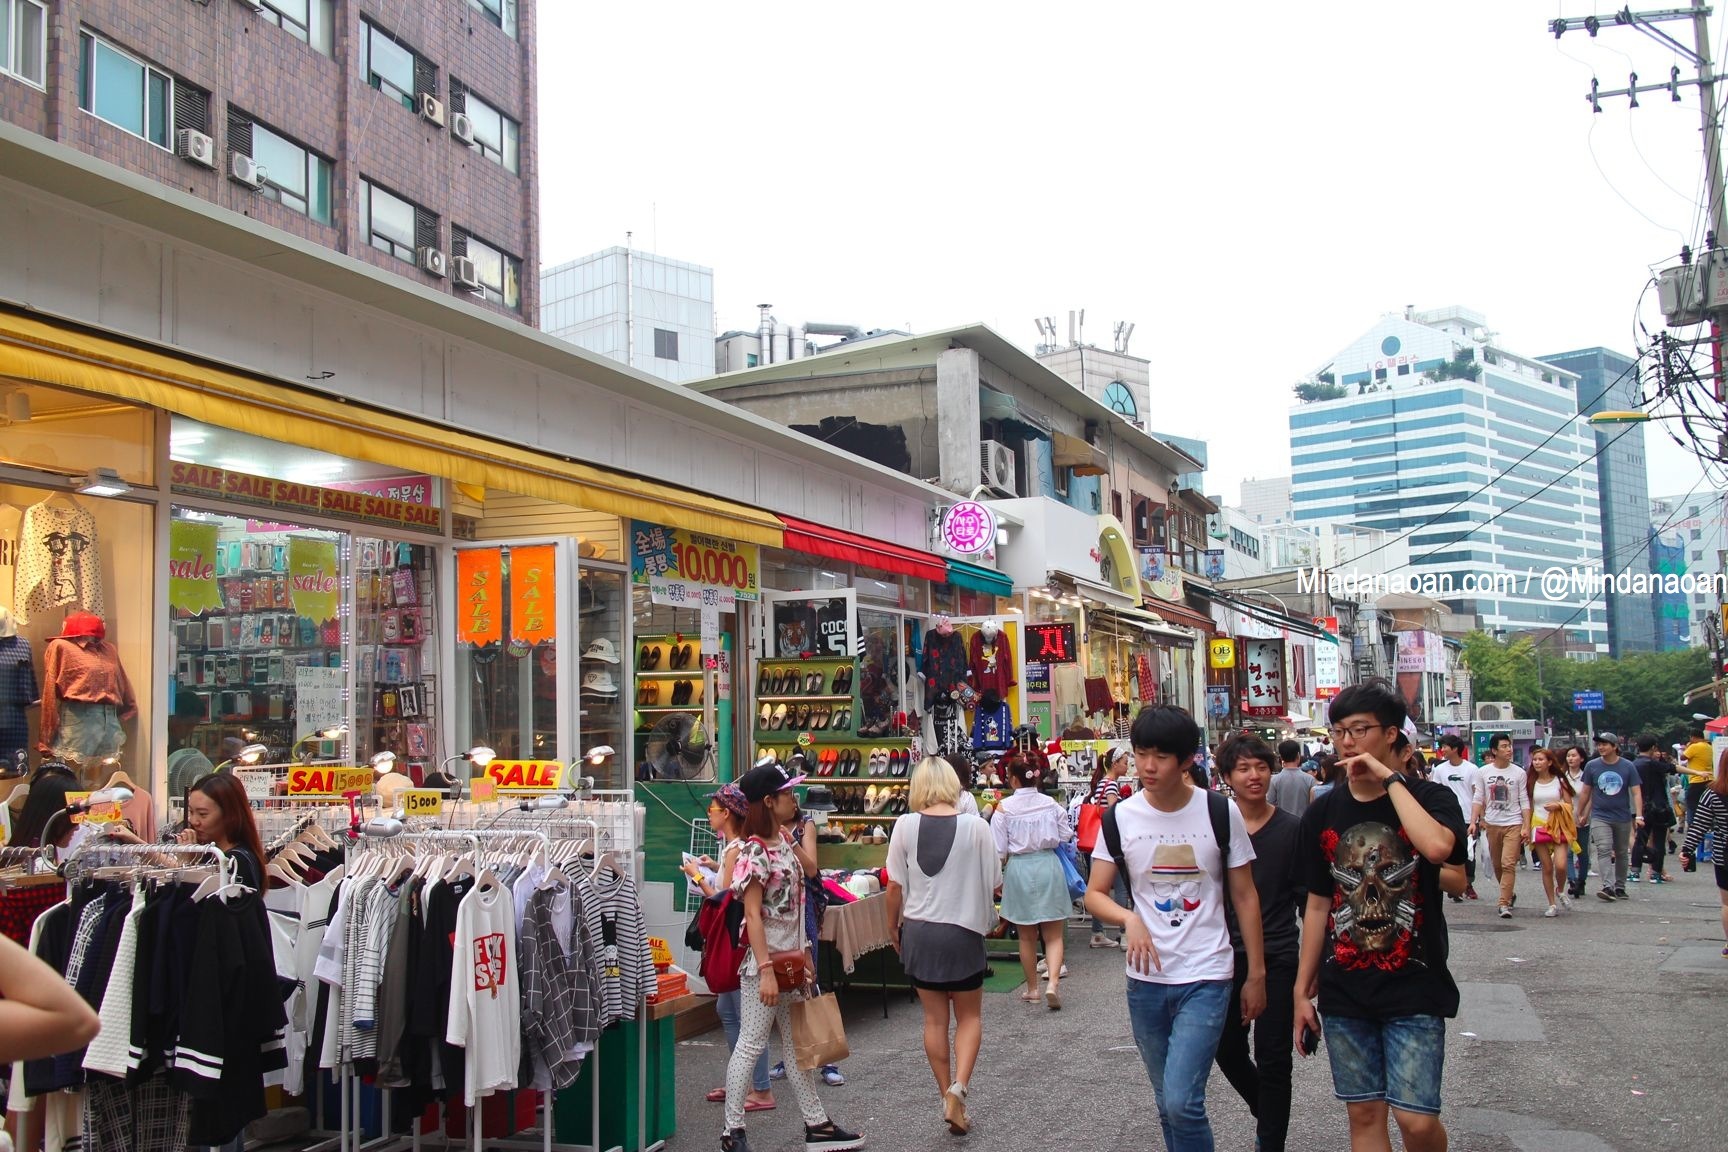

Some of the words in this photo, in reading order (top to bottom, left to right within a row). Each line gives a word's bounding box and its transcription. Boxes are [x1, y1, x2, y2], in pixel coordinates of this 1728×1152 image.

[171, 464, 223, 490] SALE
[225, 473, 273, 498] SALE
[275, 483, 320, 506] SALE
[321, 489, 361, 513] SALE
[364, 498, 403, 520] SALE
[404, 505, 440, 526] SALE
[955, 515, 975, 526] 사주
[955, 526, 975, 537] 타로
[169, 554, 214, 580] sale
[672, 542, 748, 590] 10,000
[748, 572, 756, 589] 원
[293, 569, 335, 593] sale
[469, 571, 491, 633] SALE
[521, 568, 544, 631] SALE
[827, 634, 846, 657] 5
[1038, 628, 1066, 658] 지
[1213, 646, 1231, 655] OB
[1248, 662, 1280, 681] 형제
[1251, 685, 1281, 703] 포차
[335, 773, 372, 791] 15000
[489, 763, 560, 786] SALE
[406, 794, 438, 810] 15000
